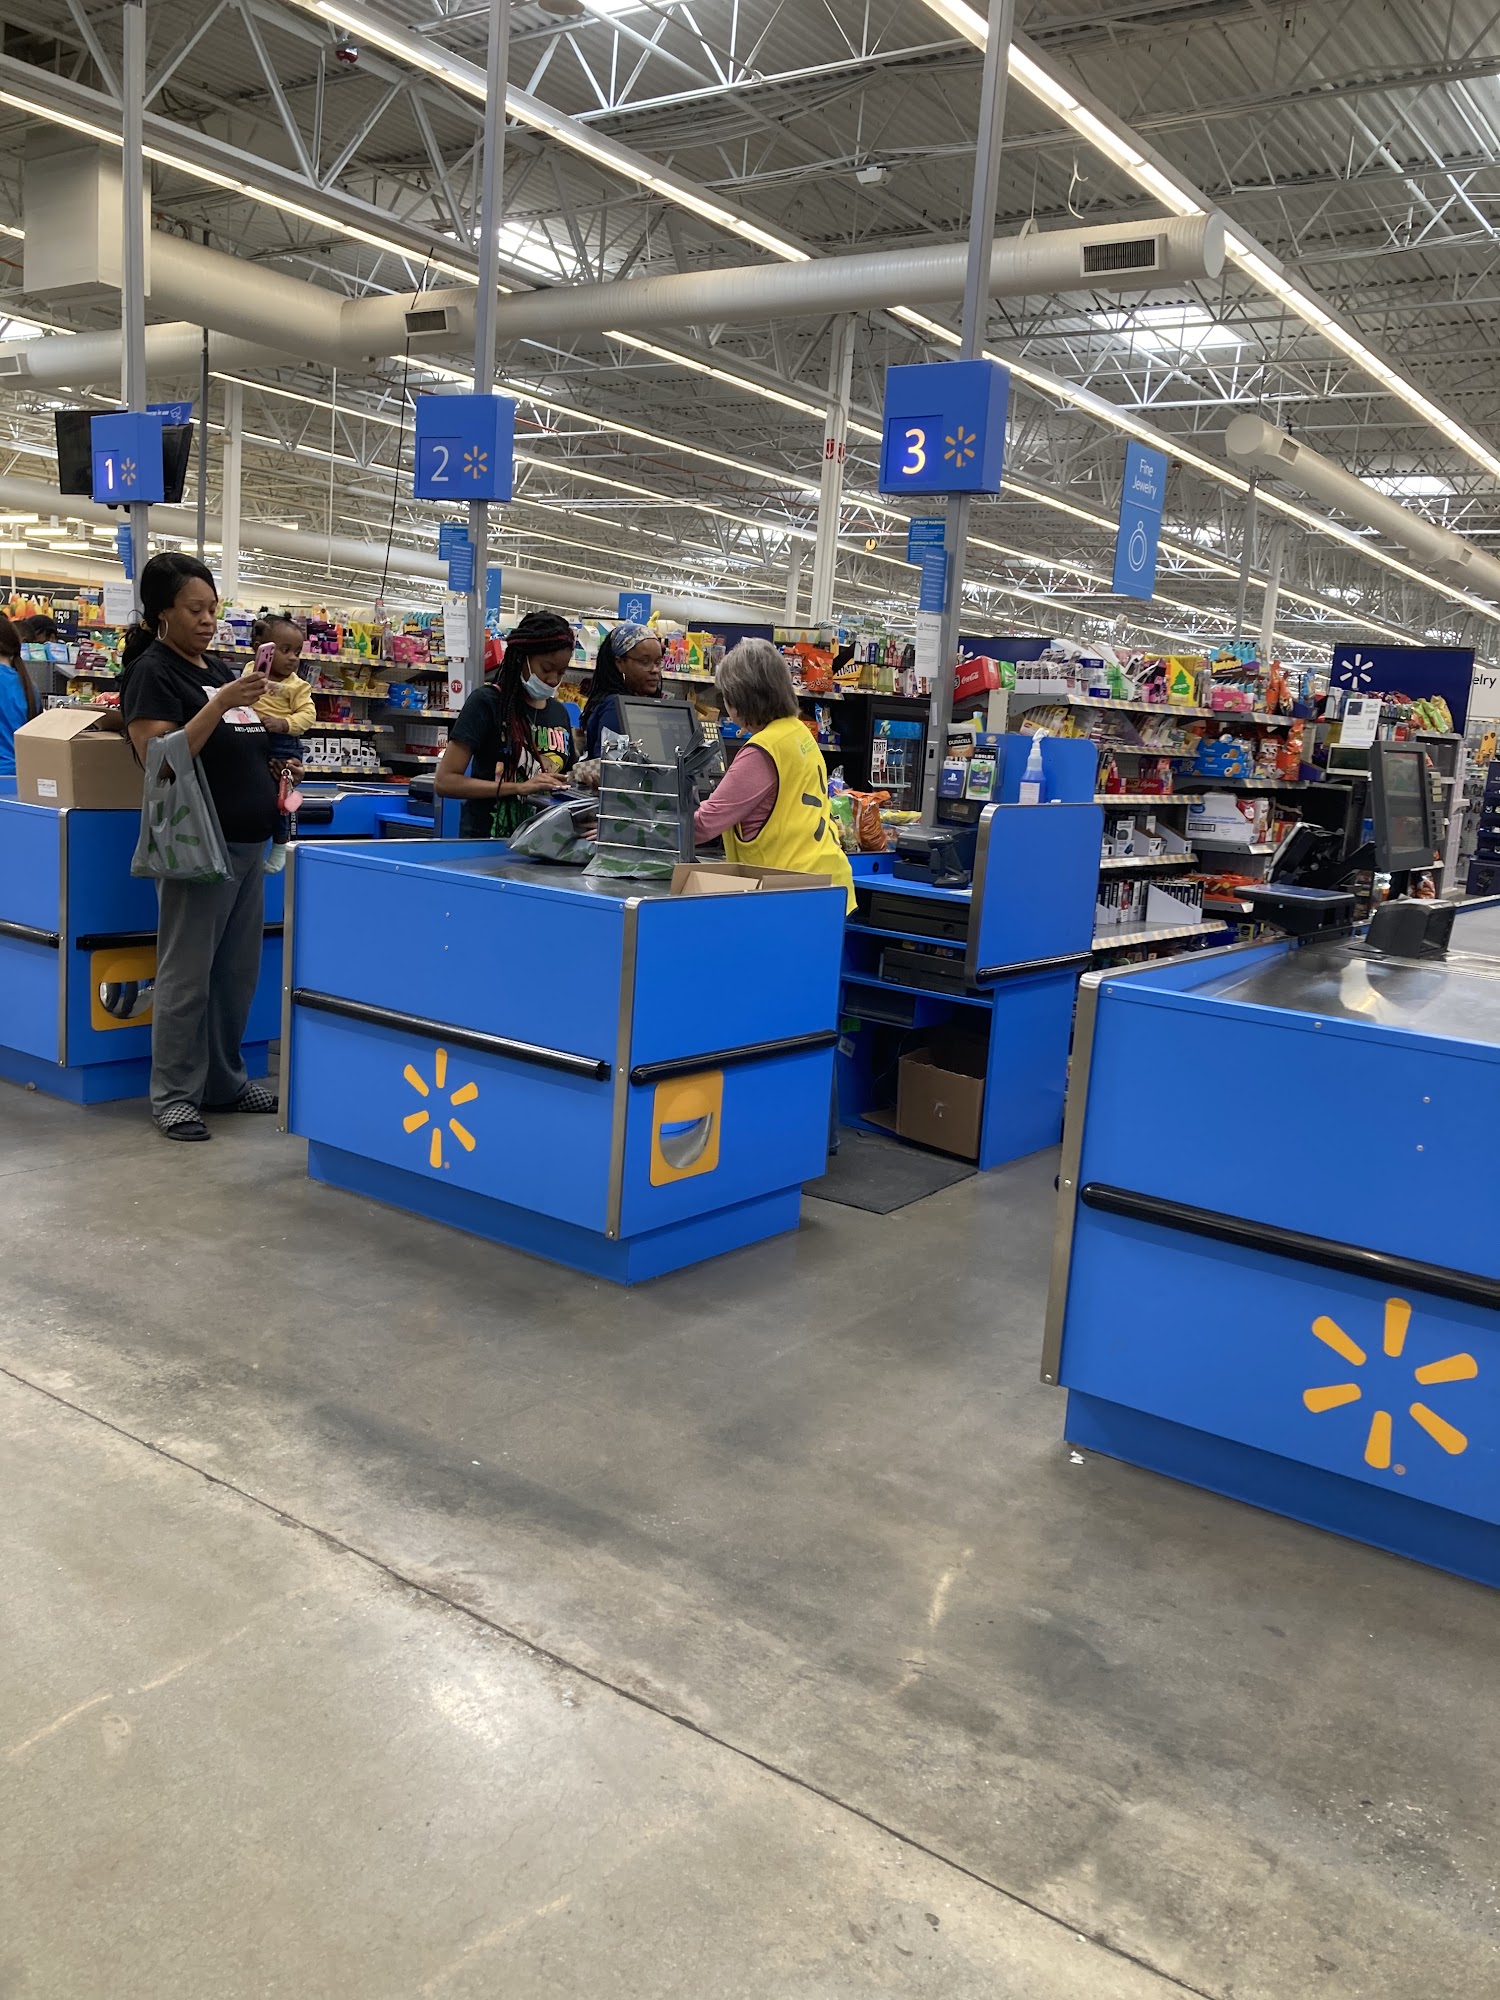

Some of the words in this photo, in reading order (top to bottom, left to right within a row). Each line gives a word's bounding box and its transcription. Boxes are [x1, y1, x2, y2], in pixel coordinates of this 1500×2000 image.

[431, 445, 449, 482] 2
[902, 428, 926, 475] 3
[105, 458, 114, 490] 1
[1139, 458, 1154, 477] Fine
[1132, 474, 1157, 500] Jewelry
[1473, 673, 1497, 689] elry
[948, 738, 971, 746] DURACELL
